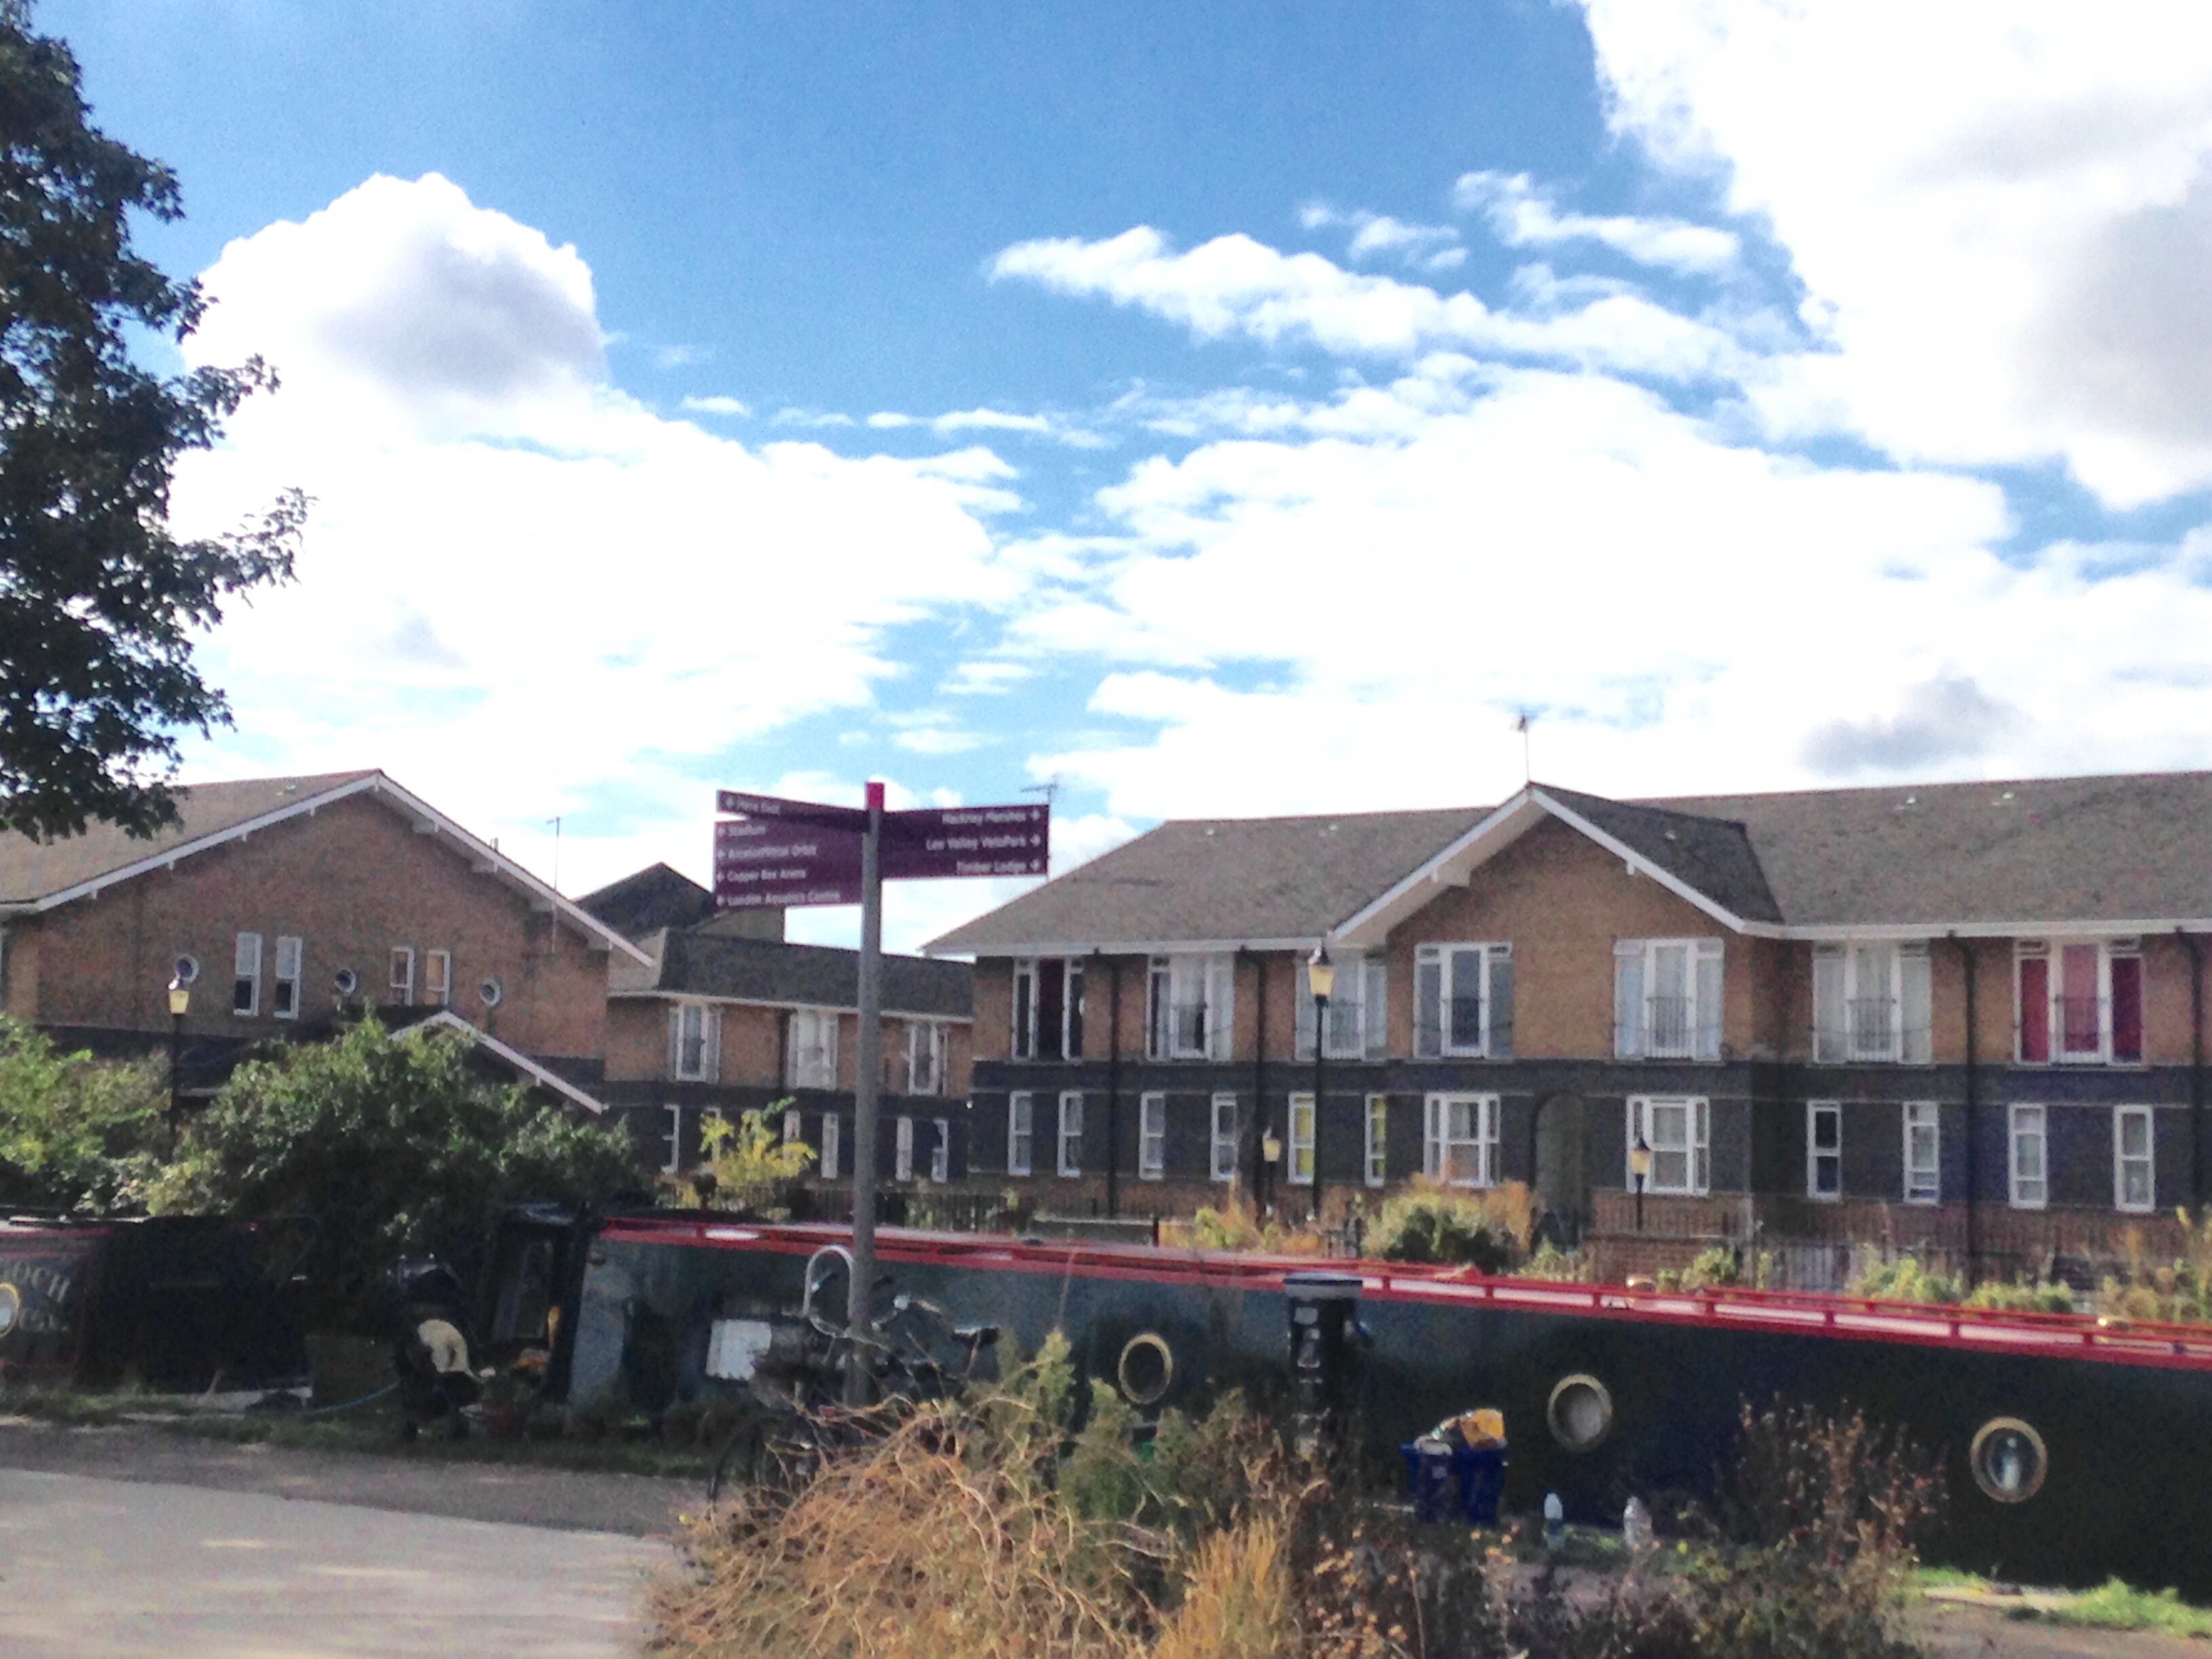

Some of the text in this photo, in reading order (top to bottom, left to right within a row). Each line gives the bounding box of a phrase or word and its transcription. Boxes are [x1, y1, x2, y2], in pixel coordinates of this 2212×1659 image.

[941, 813, 983, 826] Hackney
[728, 824, 766, 836] Stadium
[947, 837, 979, 851] Valley
[726, 869, 806, 882] Copper Box Arena
[727, 890, 841, 906] London Aquatics Centre
